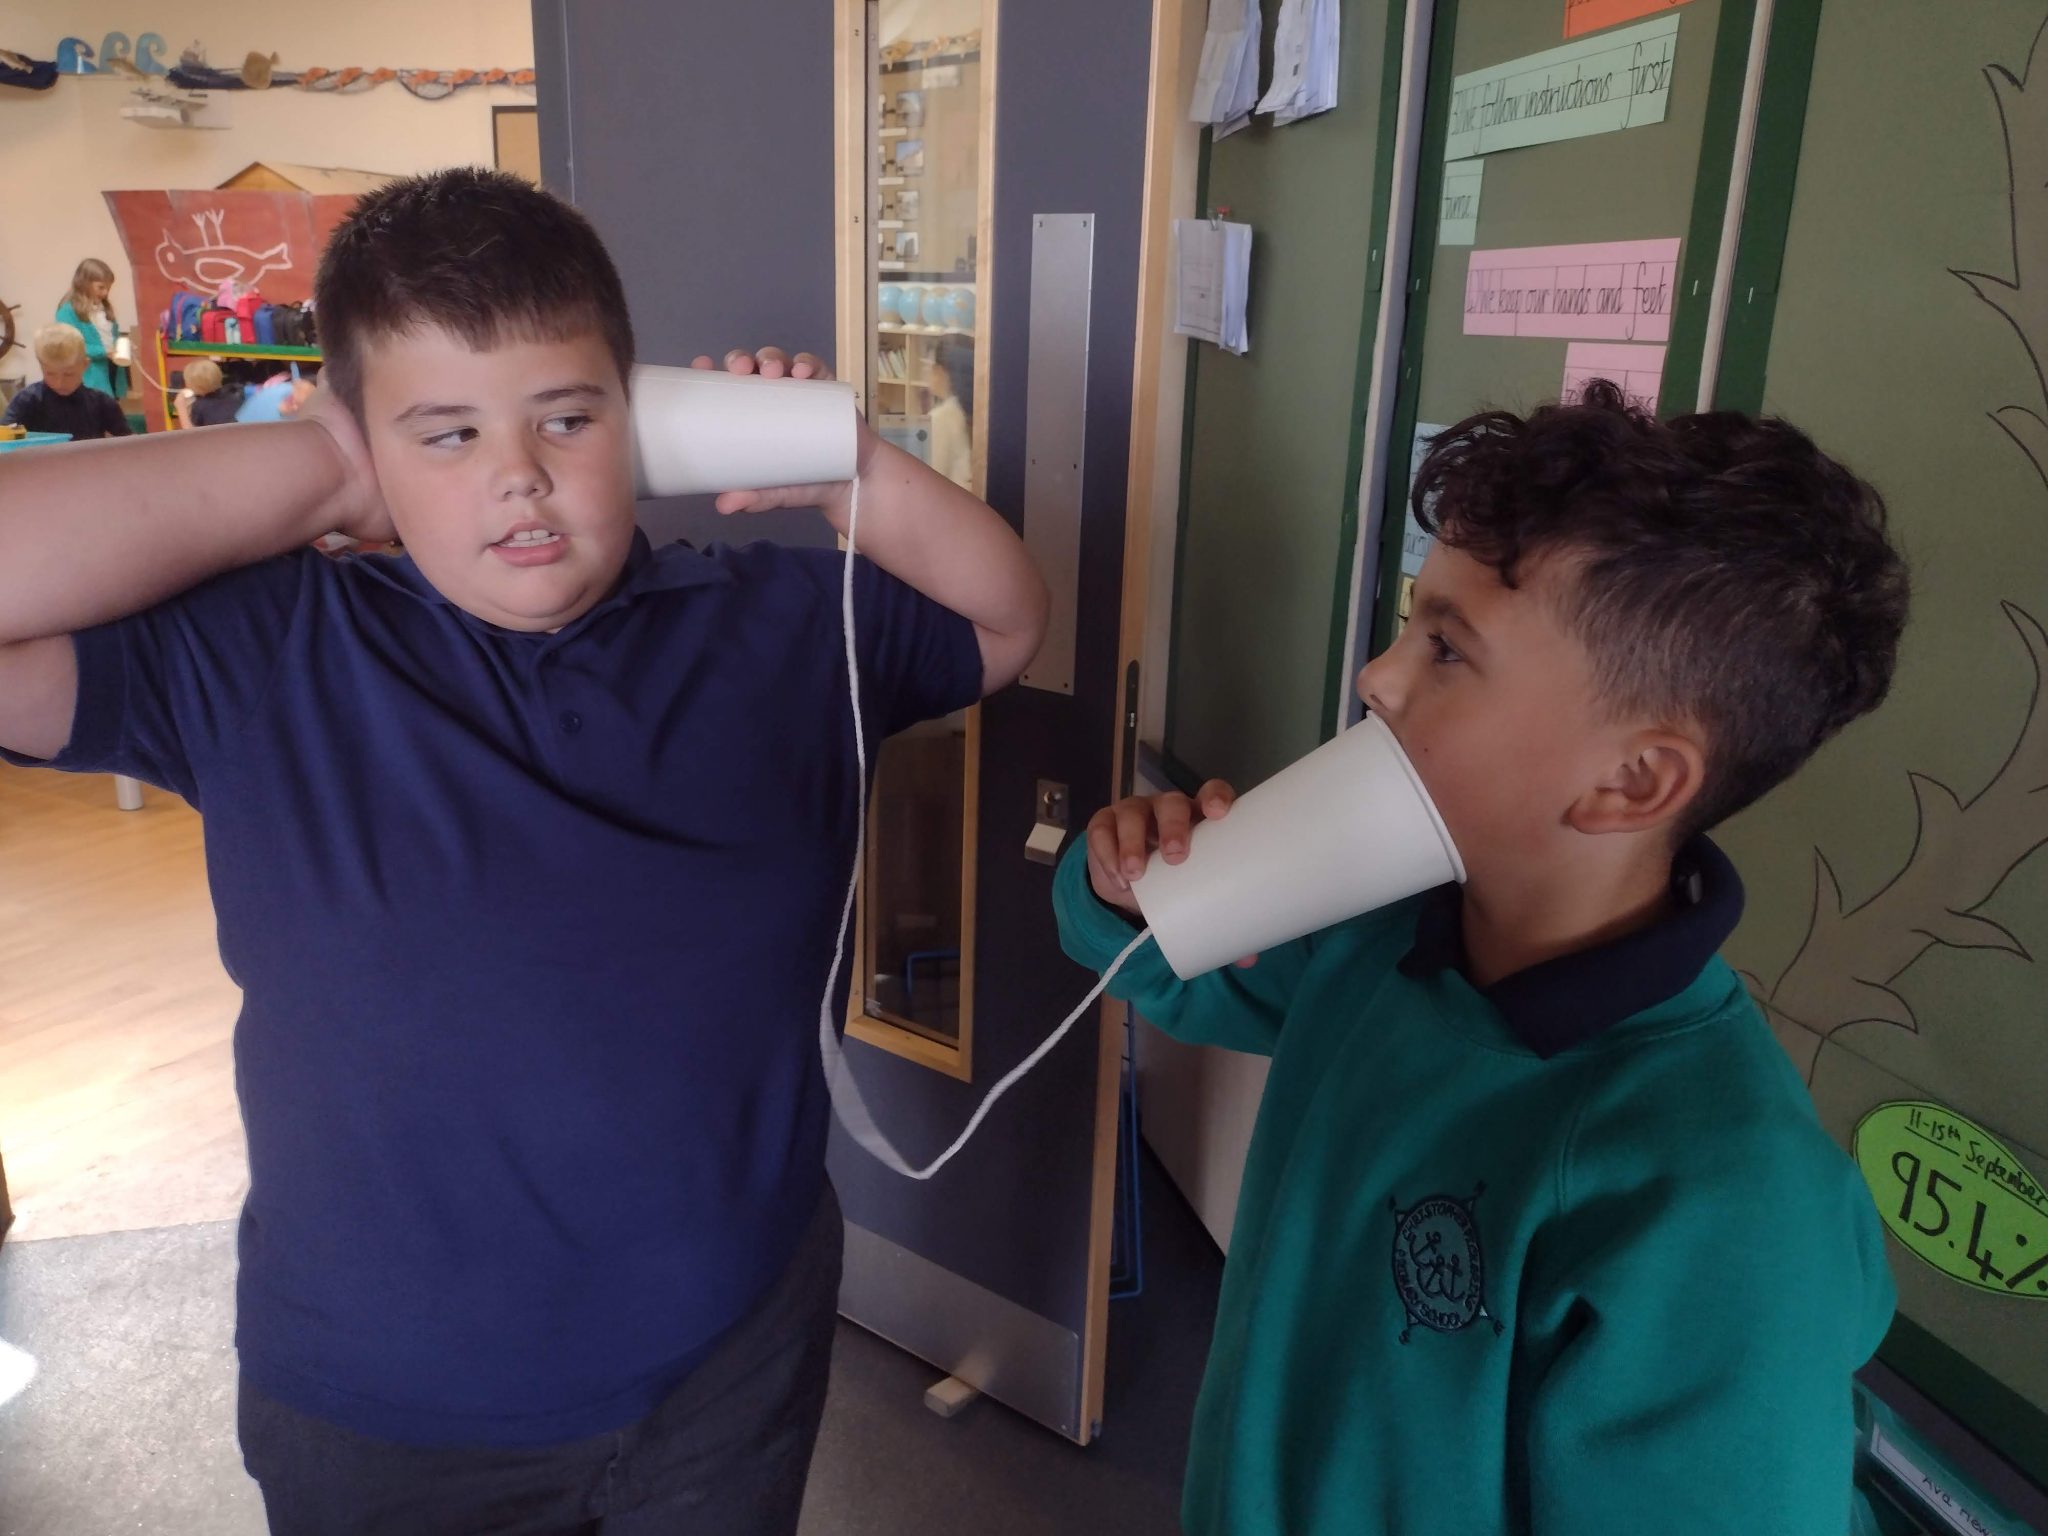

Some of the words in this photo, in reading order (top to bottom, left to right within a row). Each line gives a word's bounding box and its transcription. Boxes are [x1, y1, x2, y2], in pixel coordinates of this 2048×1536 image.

[1524, 64, 1613, 118] instructions
[1620, 42, 1671, 130] first
[1525, 289, 1551, 314] our
[1552, 264, 1591, 315] hands
[1596, 263, 1624, 314] and
[1626, 261, 1668, 340] feet
[1965, 1140, 2047, 1206] September
